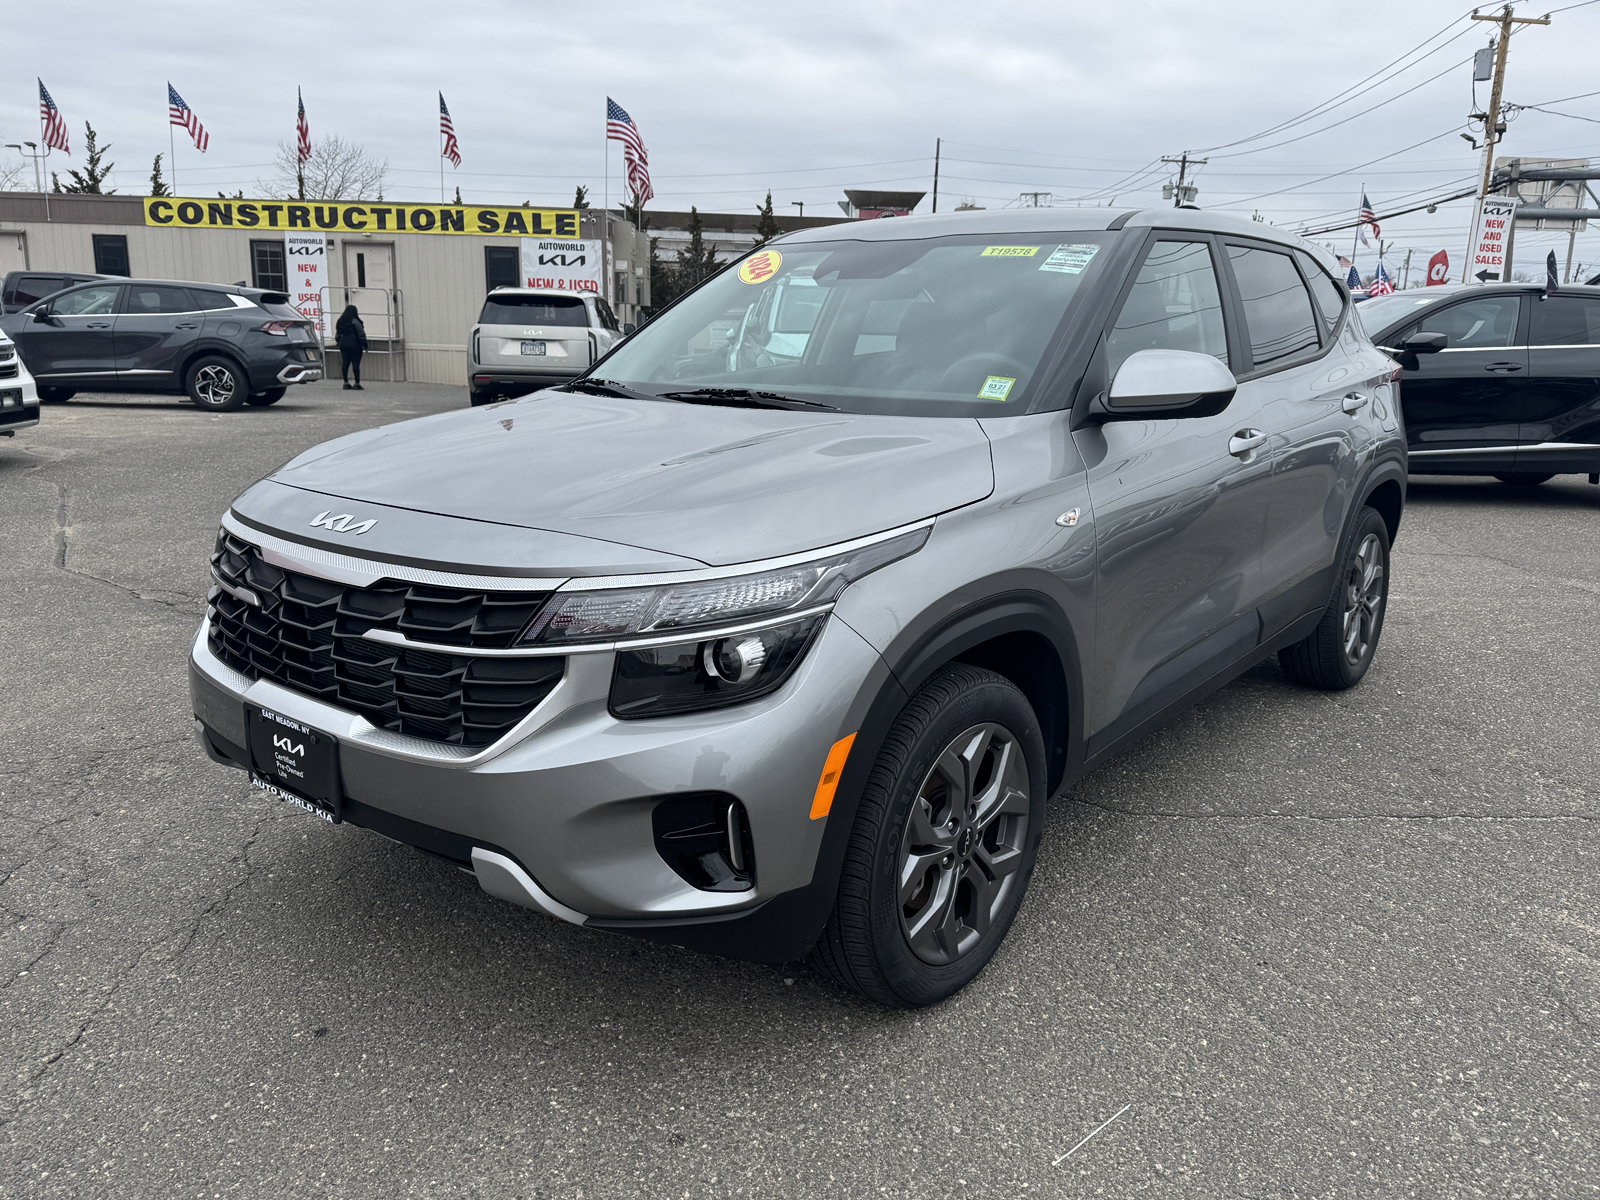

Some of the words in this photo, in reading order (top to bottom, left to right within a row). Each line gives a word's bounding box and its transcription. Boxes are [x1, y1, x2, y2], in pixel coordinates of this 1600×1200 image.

[1485, 200, 1514, 208] AUTOWORLD
[148, 201, 465, 232] CONSTRUCTION
[477, 210, 577, 237] SALE
[1485, 219, 1505, 229] NEW
[1483, 231, 1502, 241] AND
[538, 242, 585, 252] AUTOWORLD
[1479, 243, 1503, 253] USED
[538, 254, 586, 267] KIA
[1475, 255, 1503, 265] SALES
[297, 263, 318, 273] NEW
[747, 253, 773, 281] 2024
[304, 278, 312, 287] &
[527, 277, 555, 289] NEW
[569, 279, 599, 293] USED
[298, 293, 321, 302] USED
[309, 510, 379, 536] KIA
[261, 709, 275, 721] EAST
[301, 725, 311, 736] NY
[273, 733, 305, 758] KIA
[274, 751, 296, 767] Certified
[275, 760, 304, 779] Pre-Owned
[277, 768, 288, 779] Lite
[252, 778, 278, 796] AUTO
[279, 790, 314, 813] WORLD
[315, 807, 334, 824] KIA
[884, 761, 926, 877] SOLUS
